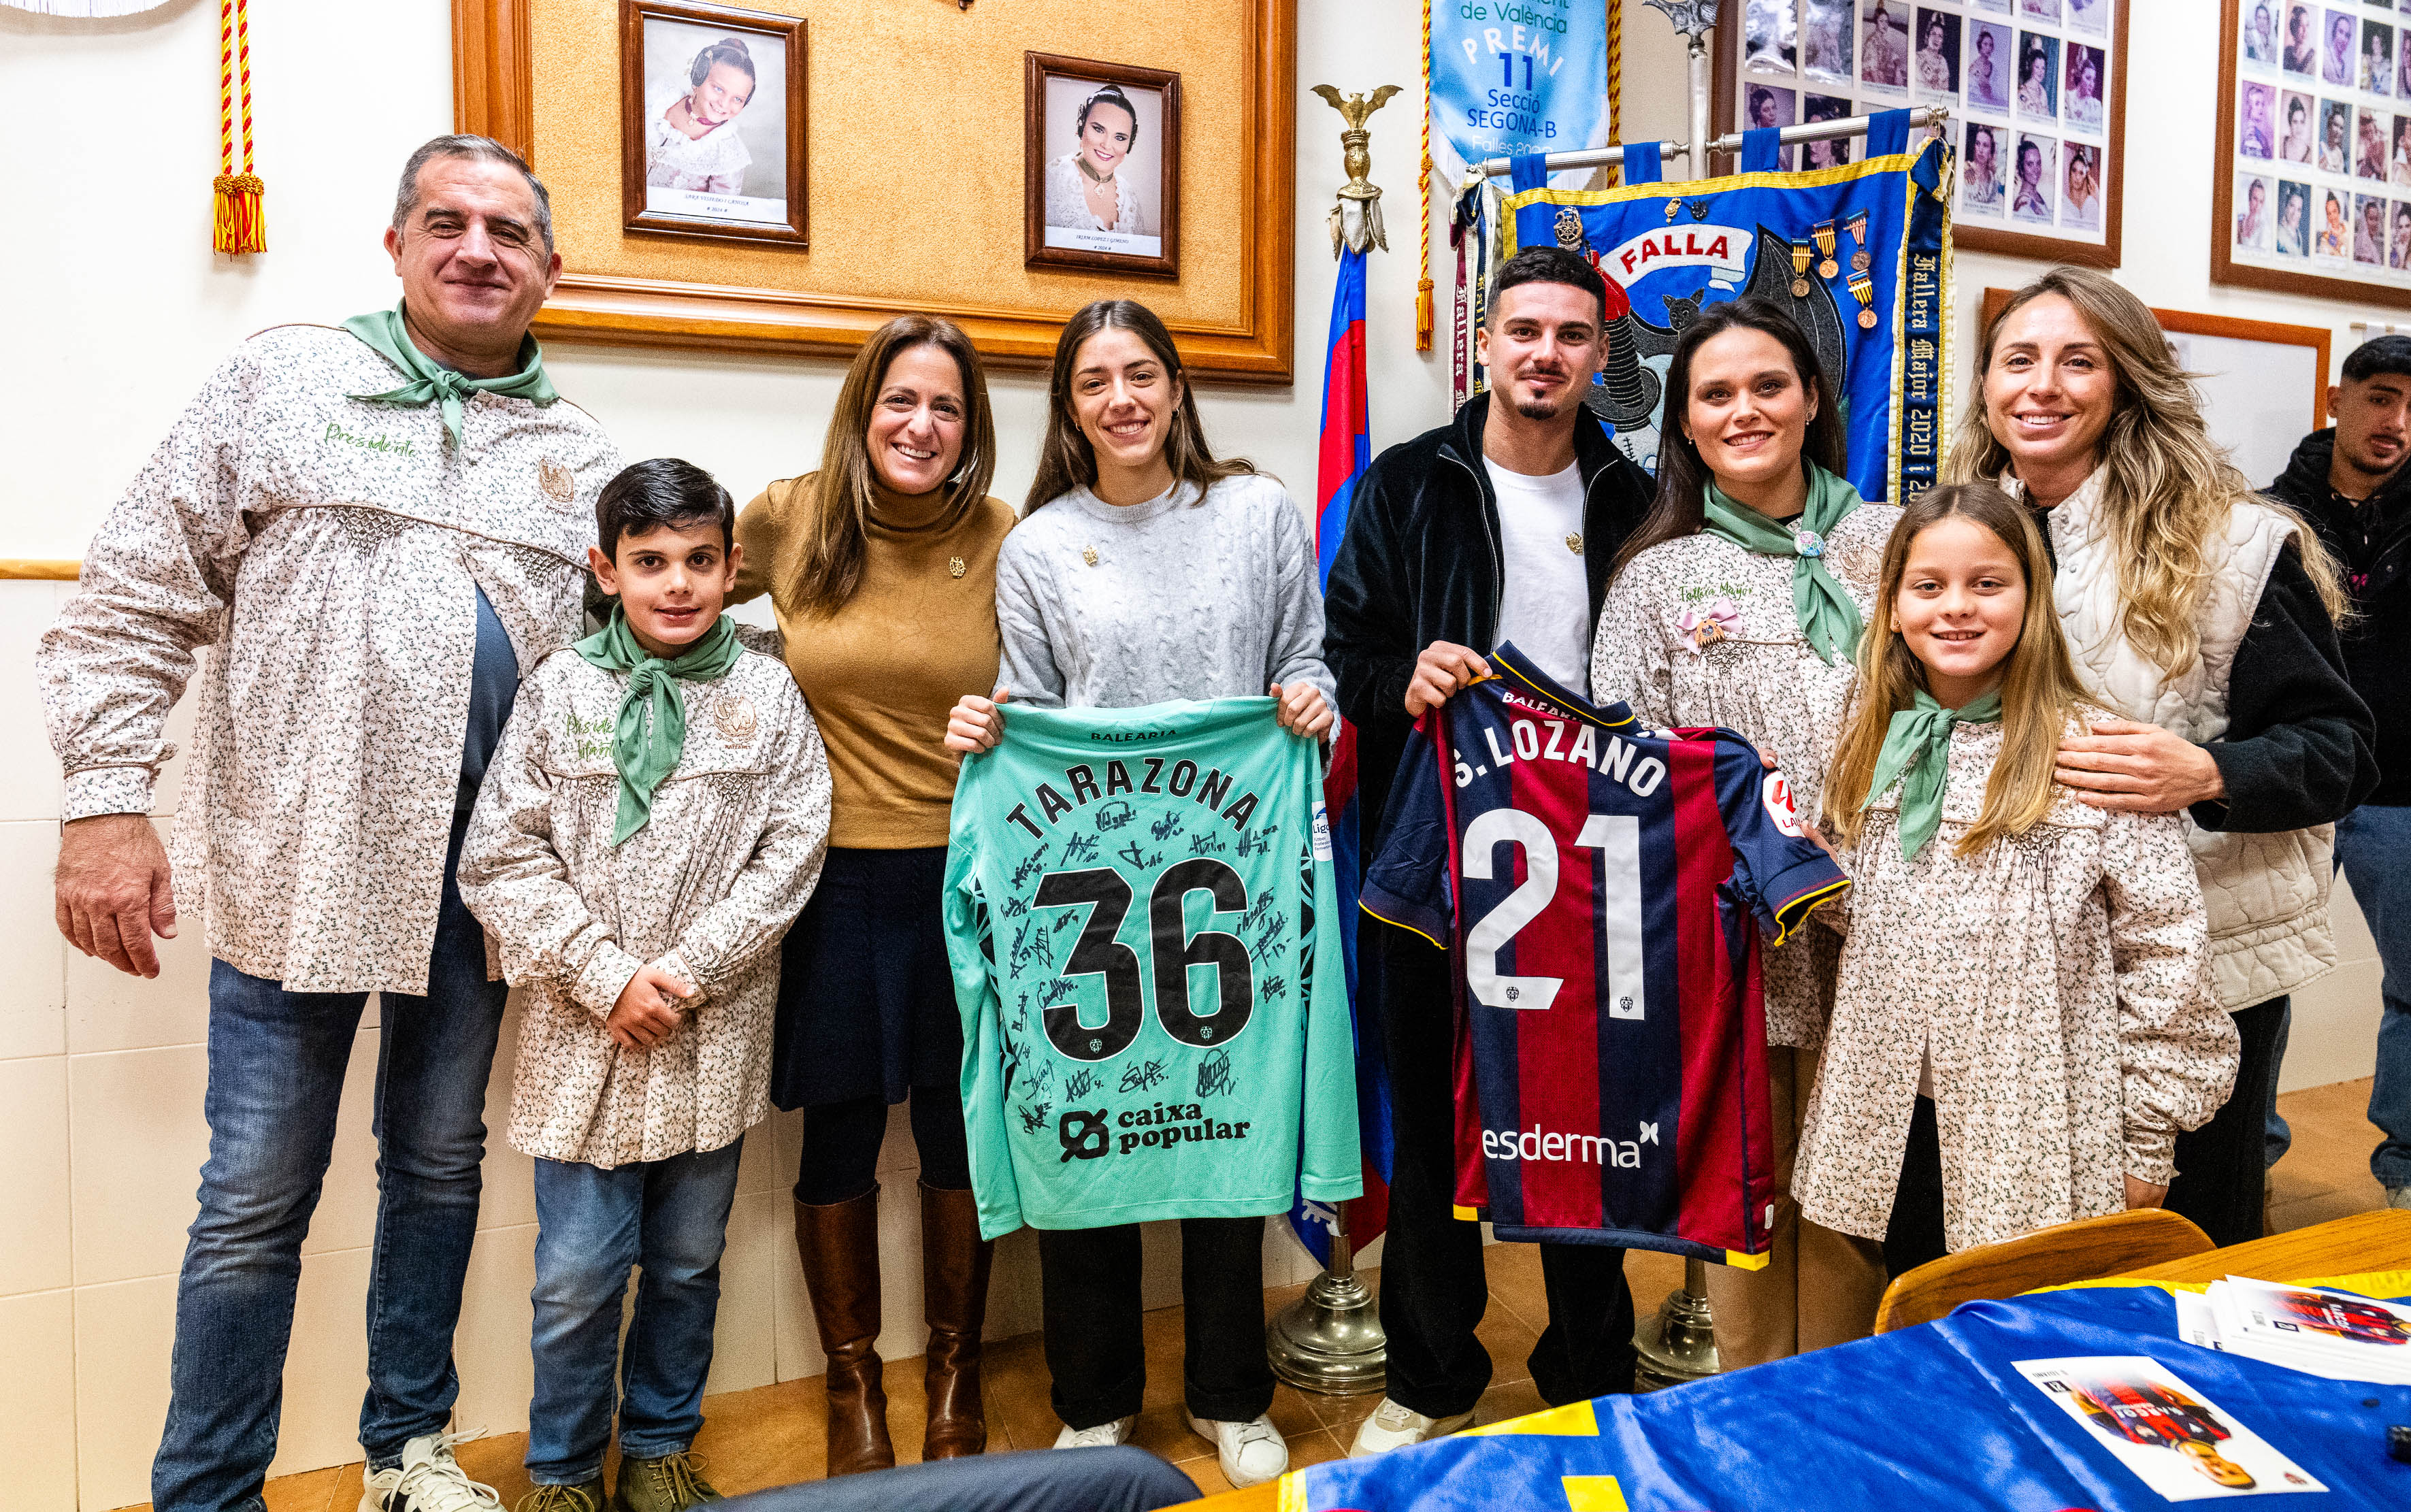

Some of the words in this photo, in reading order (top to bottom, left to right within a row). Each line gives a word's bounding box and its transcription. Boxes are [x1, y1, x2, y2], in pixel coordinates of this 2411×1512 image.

[1461, 4, 1487, 21] de
[1493, 3, 1567, 33] València
[1462, 25, 1564, 76] PREMI
[1498, 52, 1533, 91] 11
[1466, 108, 1557, 138] SEGONA-B
[1488, 89, 1540, 114] Secció
[1472, 136, 1513, 156] Falles
[1620, 233, 1728, 274] FALLA
[1912, 253, 1936, 329] Fallera
[1455, 284, 1467, 376] Fallera
[1907, 339, 1935, 400] Major
[324, 422, 418, 457] Presidente
[1909, 409, 1932, 456] 2020
[1091, 729, 1177, 742] BALEARIA
[1454, 749, 1488, 788] S.
[1483, 719, 1667, 797] LOZANO
[1005, 757, 1260, 840] TARAZONA
[1462, 808, 1645, 1020] 21
[1030, 857, 1255, 1063] 36
[1118, 1102, 1203, 1128] caixa
[1118, 1118, 1251, 1155] popular
[1481, 1123, 1641, 1169] esderma
